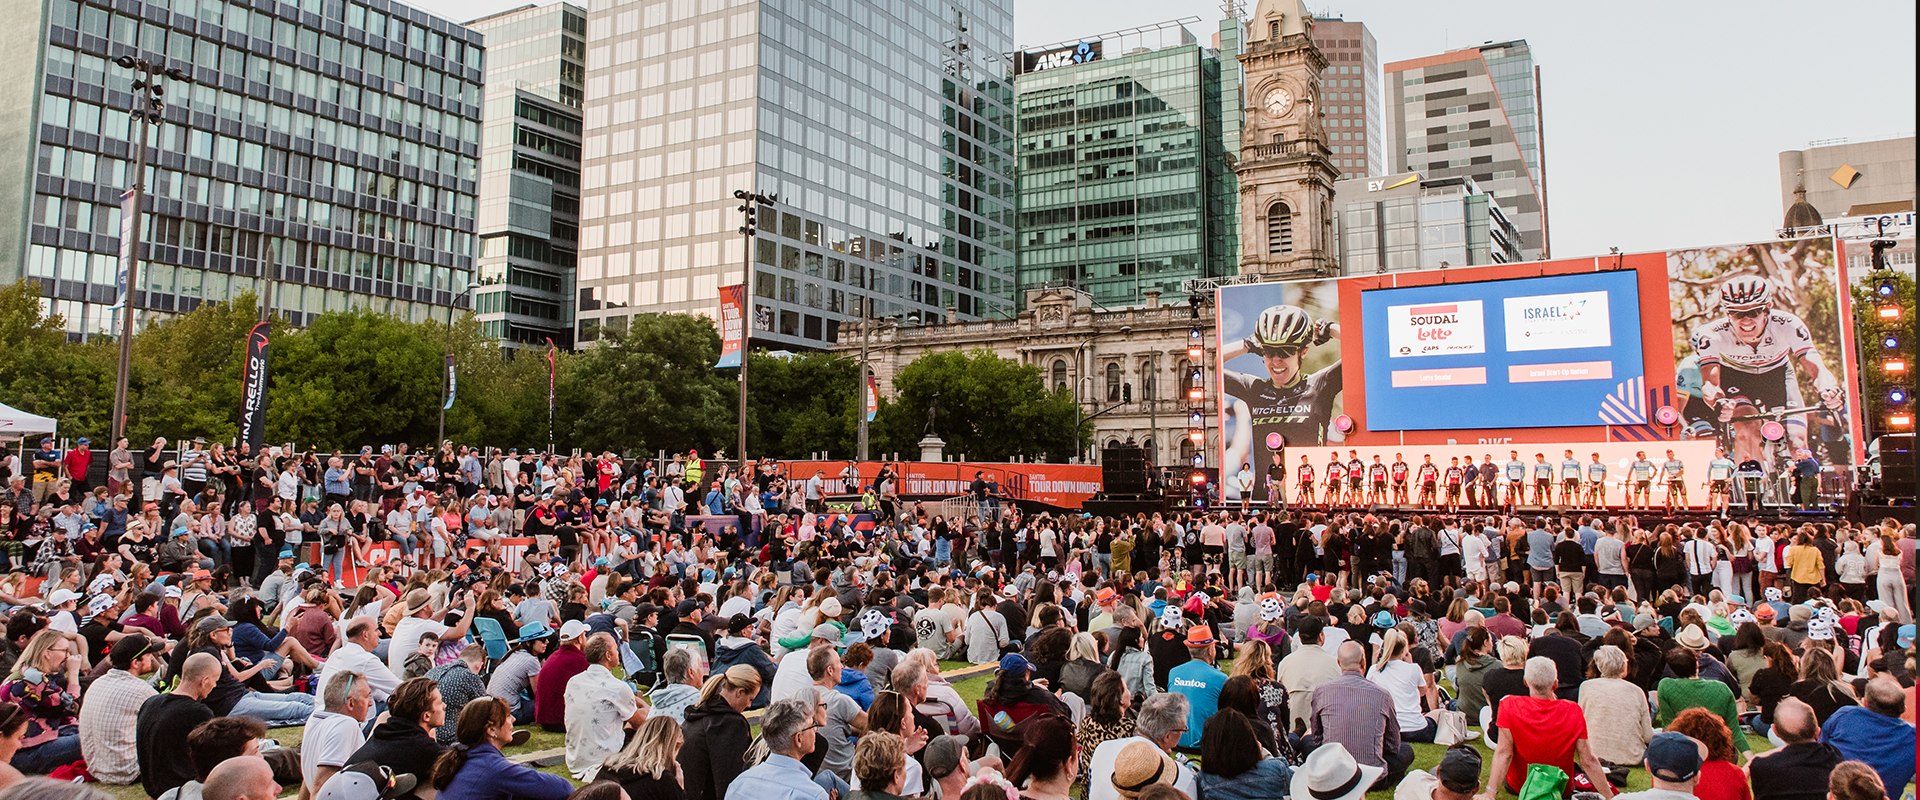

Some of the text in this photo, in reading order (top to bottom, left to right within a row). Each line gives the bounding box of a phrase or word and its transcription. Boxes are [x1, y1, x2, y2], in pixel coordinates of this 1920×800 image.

[1034, 50, 1073, 72] ANZ
[1368, 180, 1385, 191] EY
[723, 308, 740, 319] TOUR
[1524, 306, 1561, 319] ISRAEL
[1410, 315, 1458, 326] SOUDAL
[725, 329, 742, 341] UNDE
[242, 355, 259, 443] INARELLO
[1252, 404, 1311, 415] MITCHELTON
[1252, 416, 1309, 426] SCOTT
[906, 473, 926, 481] SANTOS
[907, 481, 932, 494] TOUR
[933, 481, 963, 494] DOWN
[1029, 481, 1101, 494] TOUR DOWN UNDER
[1174, 677, 1206, 689] Santos
